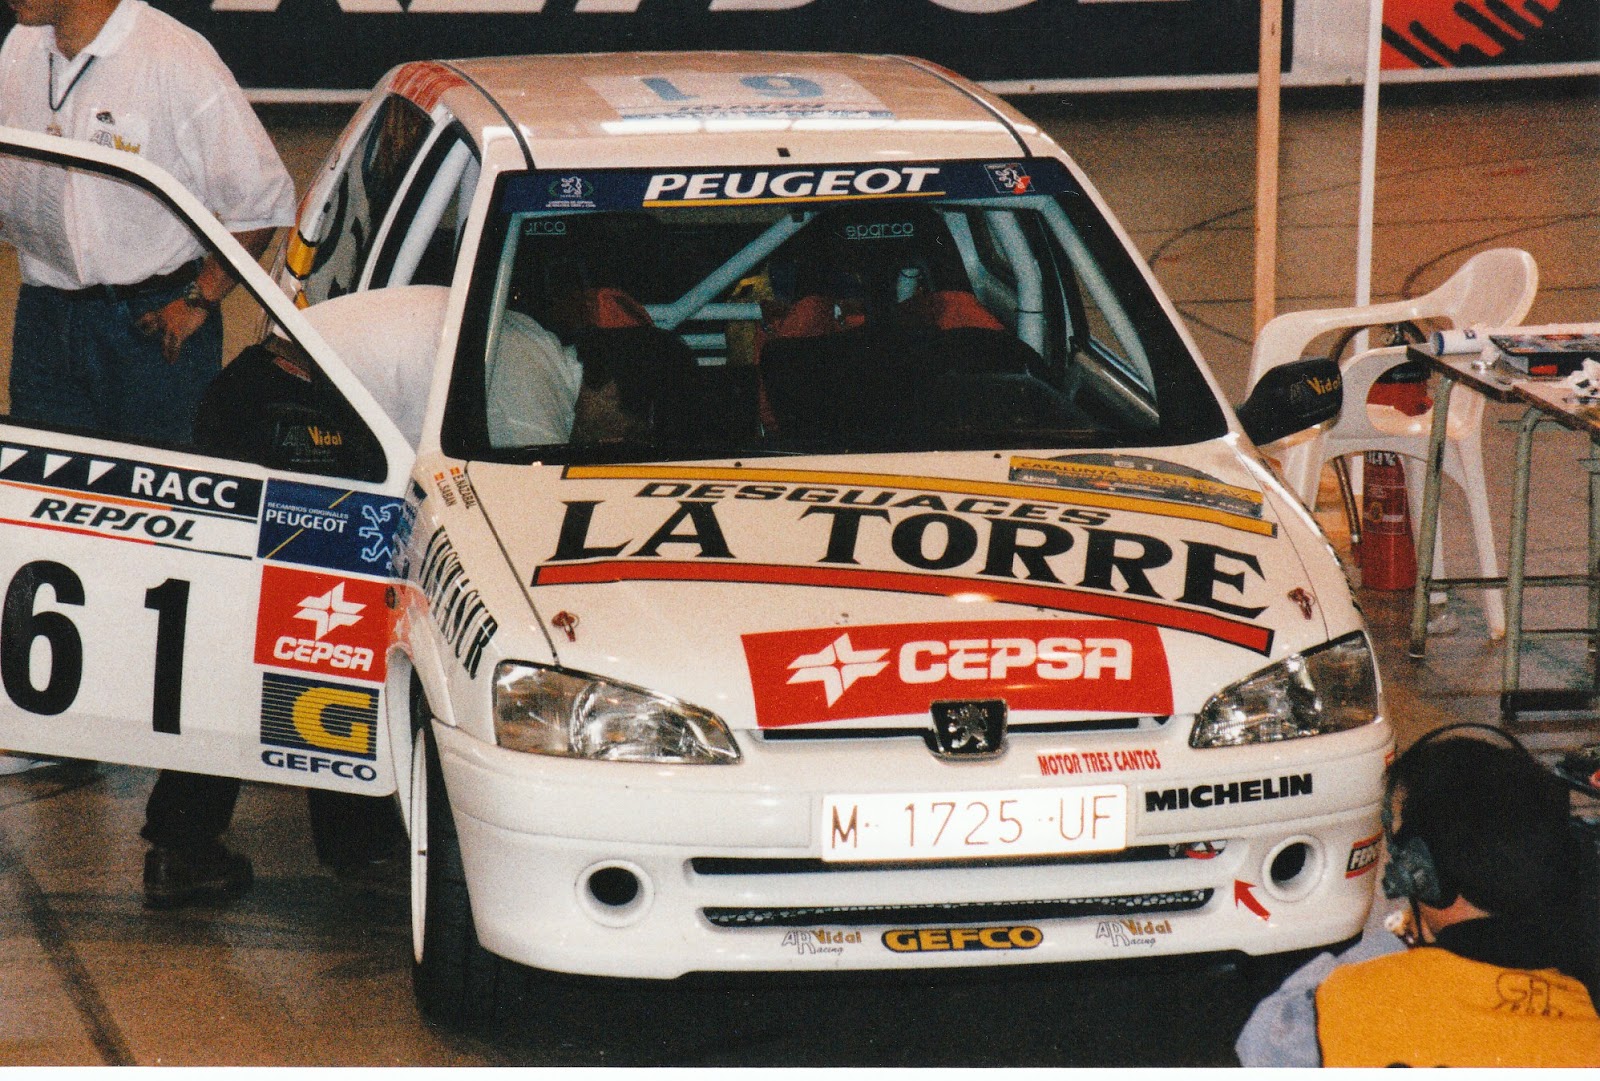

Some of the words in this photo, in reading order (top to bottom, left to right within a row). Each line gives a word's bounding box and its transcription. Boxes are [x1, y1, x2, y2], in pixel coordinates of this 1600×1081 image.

[643, 167, 940, 202] PEUGEOT
[524, 220, 567, 236] arco
[845, 222, 914, 241] sparco
[131, 465, 239, 510] RACC
[634, 481, 1111, 527] DESGUACES
[31, 497, 196, 542] REPSOL
[265, 508, 348, 534] PEUGEOT
[267, 501, 307, 514] RECAMBIOS
[308, 507, 349, 520] ORIGINALES
[545, 499, 737, 560] LA
[800, 504, 1271, 619] TORRE
[1, 559, 192, 736] 61
[272, 635, 375, 673] CEPSA
[898, 636, 1133, 684] CEPSA
[260, 749, 378, 783] GEFCO
[1038, 752, 1082, 776] MOTOR
[1081, 751, 1113, 774] TRES
[1113, 749, 1161, 771] CANTOS
[1146, 773, 1312, 813] MICHELIN
[904, 800, 1022, 848] 1725
[1059, 794, 1117, 841] UF
[810, 928, 862, 944] Vidal
[886, 926, 1041, 952] GEFCO
[1120, 919, 1173, 936] Vidal
